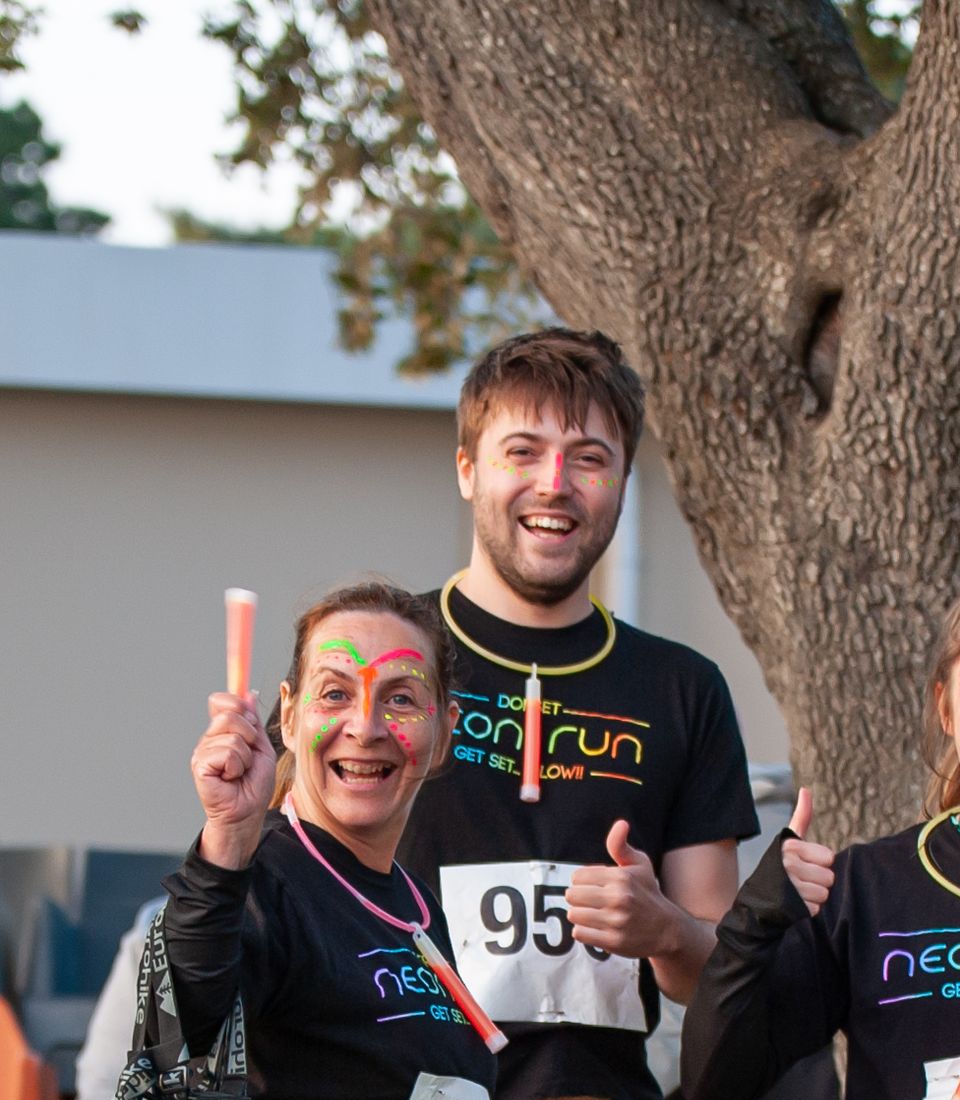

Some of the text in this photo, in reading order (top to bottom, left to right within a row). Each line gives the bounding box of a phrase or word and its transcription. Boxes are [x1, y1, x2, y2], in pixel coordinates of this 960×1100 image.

[498, 693, 562, 716] DOET
[453, 745, 486, 764] GET
[540, 763, 584, 780] LOW!!
[479, 884, 612, 962] 95
